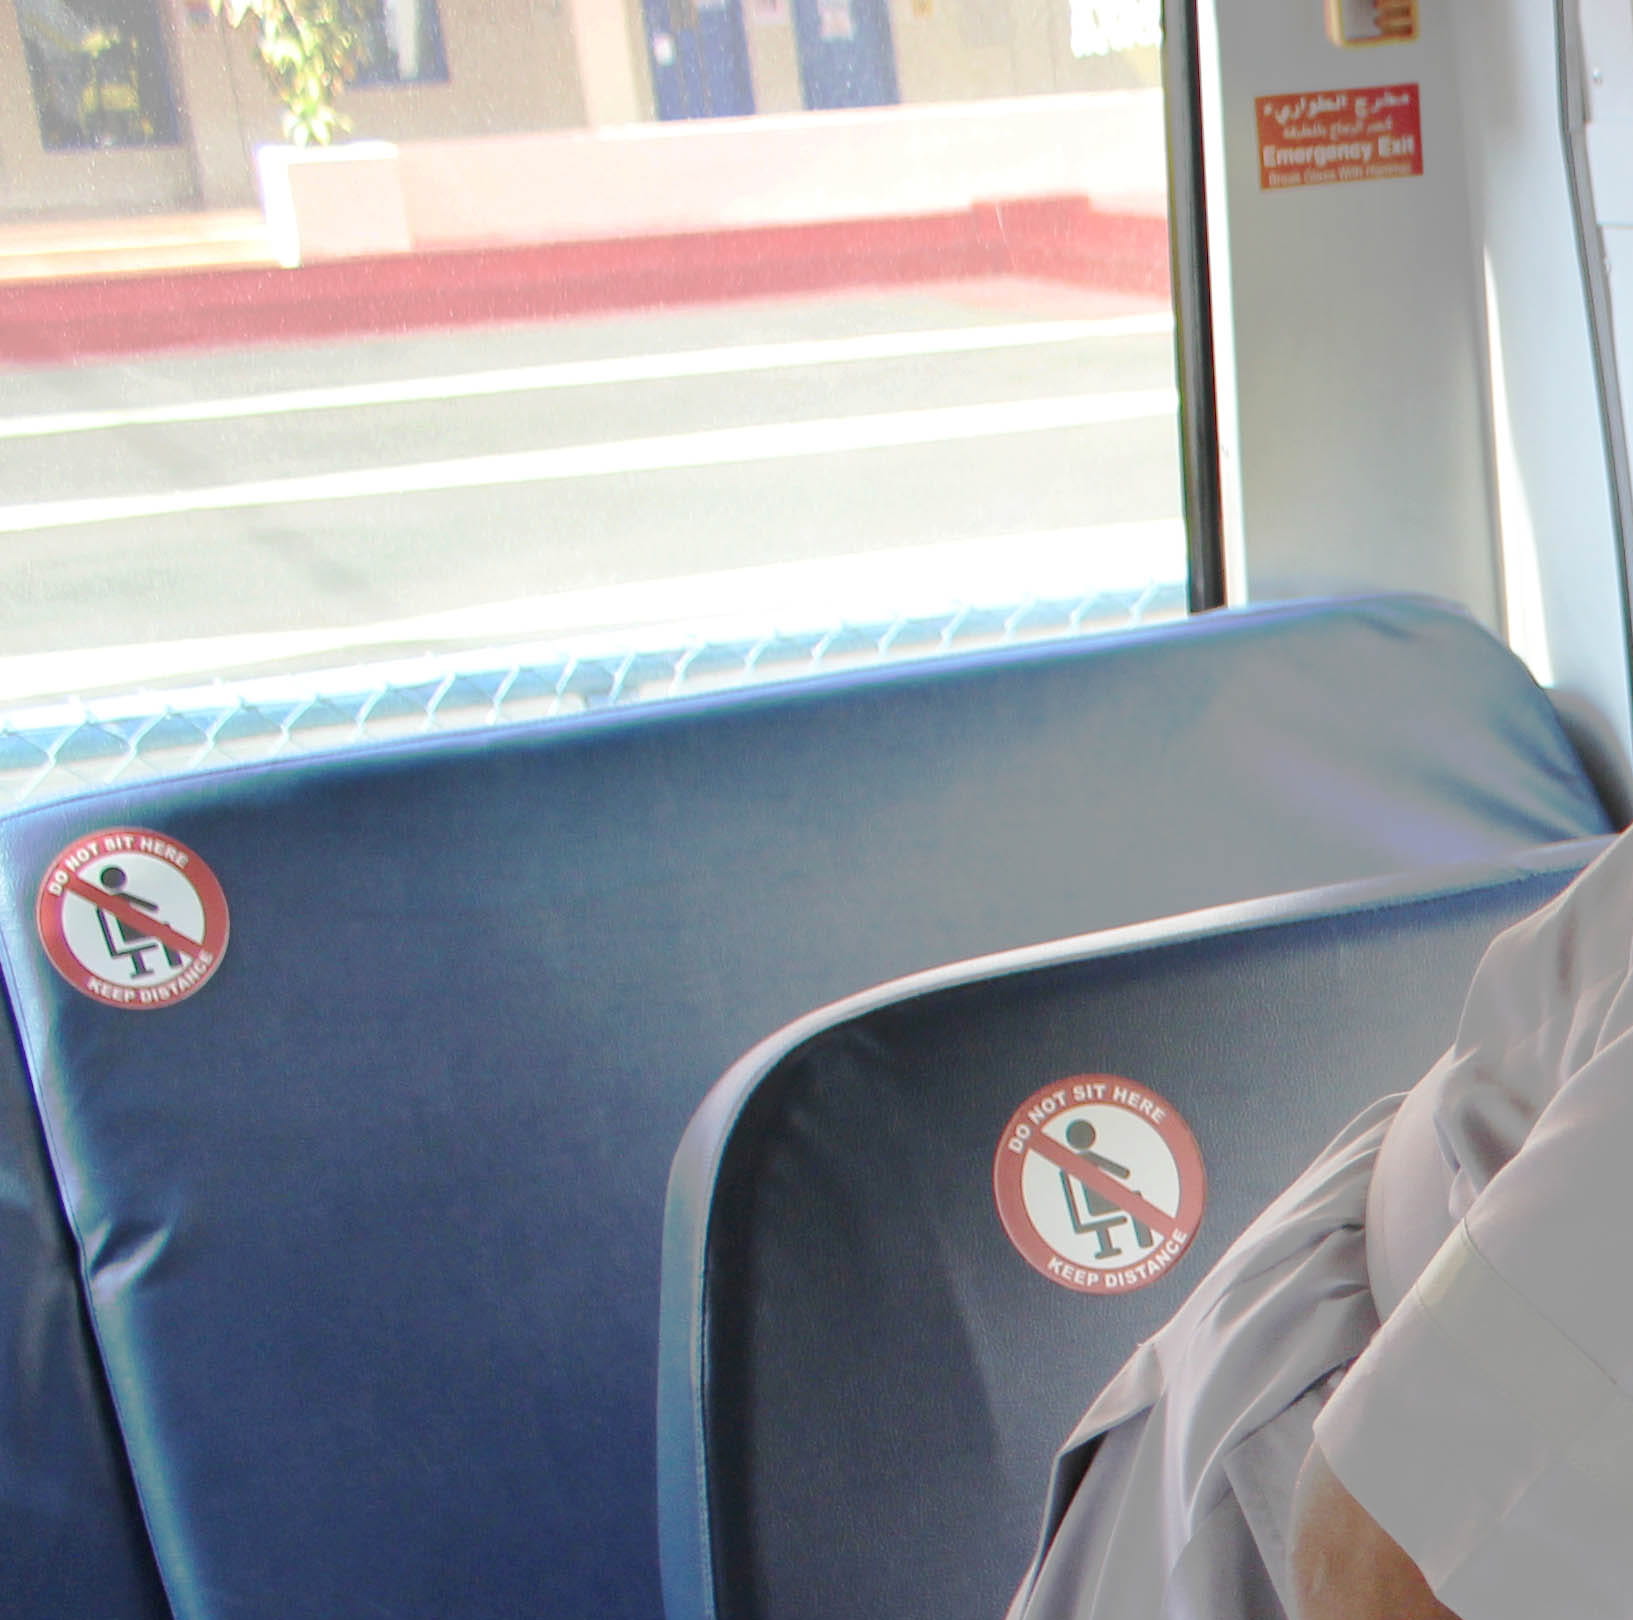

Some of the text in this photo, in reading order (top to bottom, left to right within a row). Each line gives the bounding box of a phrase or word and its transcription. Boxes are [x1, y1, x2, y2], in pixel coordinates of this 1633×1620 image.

[1262, 135, 1415, 168] Emergency Exit
[47, 872, 71, 897] DO
[65, 842, 101, 872] NOT
[139, 836, 190, 869] HERE
[86, 949, 214, 1004] KEEP DISTANCE
[1007, 1083, 1167, 1154] DO NOT SIT HERE
[1047, 1228, 1188, 1289] KEEP DISTANCE
